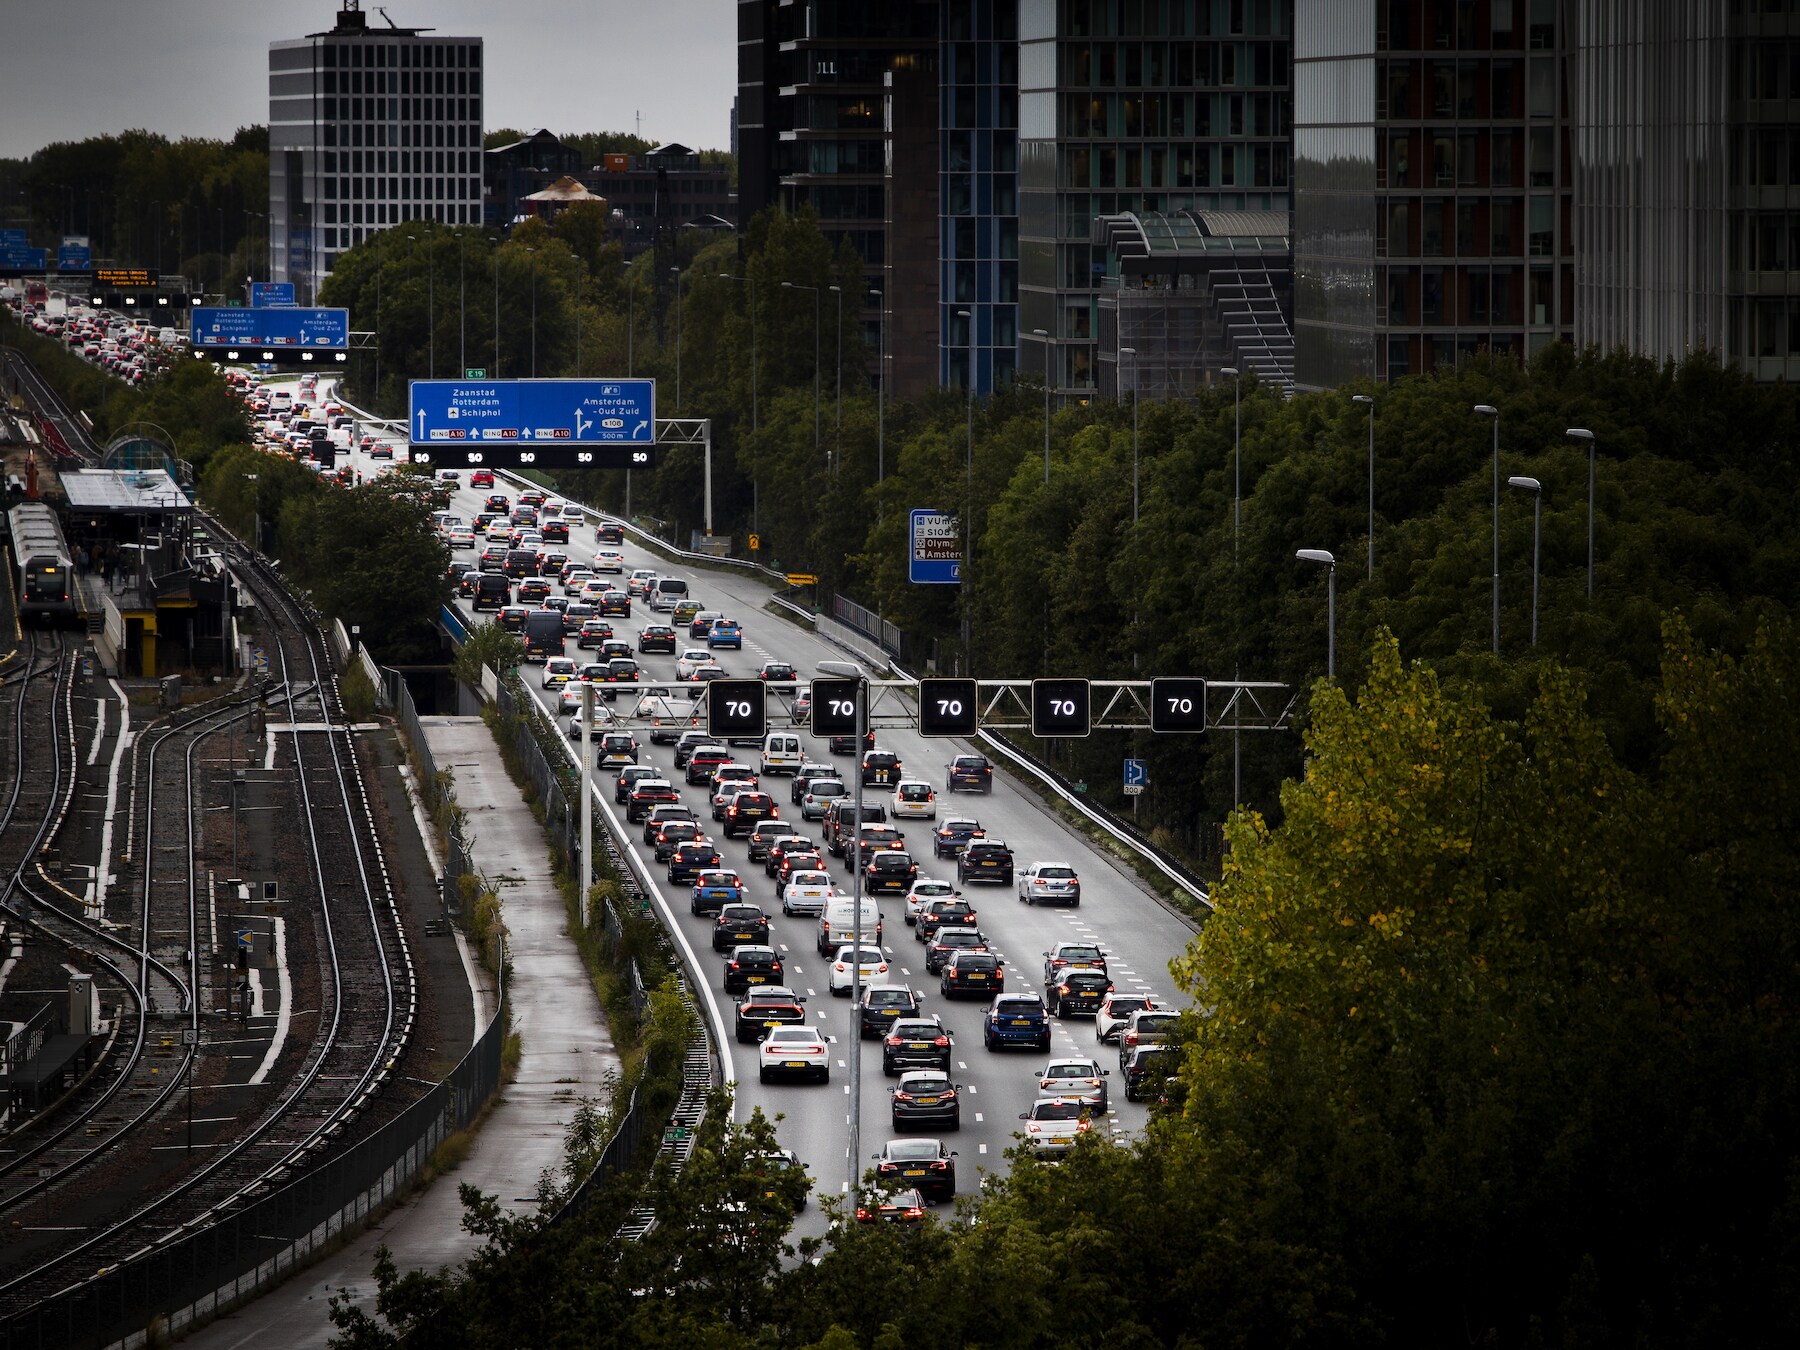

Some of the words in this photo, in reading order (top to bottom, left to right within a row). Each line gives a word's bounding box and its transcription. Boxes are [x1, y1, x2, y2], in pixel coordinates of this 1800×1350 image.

[816, 62, 837, 74] JLL
[452, 389, 496, 397] Zaanstad
[452, 398, 500, 406] Rotterdam
[583, 398, 635, 406] Amsterdam
[461, 409, 501, 418] Schiphol
[619, 407, 640, 415] Zuid
[450, 430, 465, 438] A10
[414, 453, 429, 463] 50
[468, 453, 483, 463] 50
[521, 453, 536, 463] 50
[578, 453, 593, 463] 50
[633, 453, 648, 463] 50
[726, 701, 752, 717] 70
[828, 700, 854, 716] 70
[937, 700, 962, 716] 70
[1050, 700, 1075, 716] 70
[1168, 698, 1192, 714] 70
[186, 1032, 194, 1042] S
